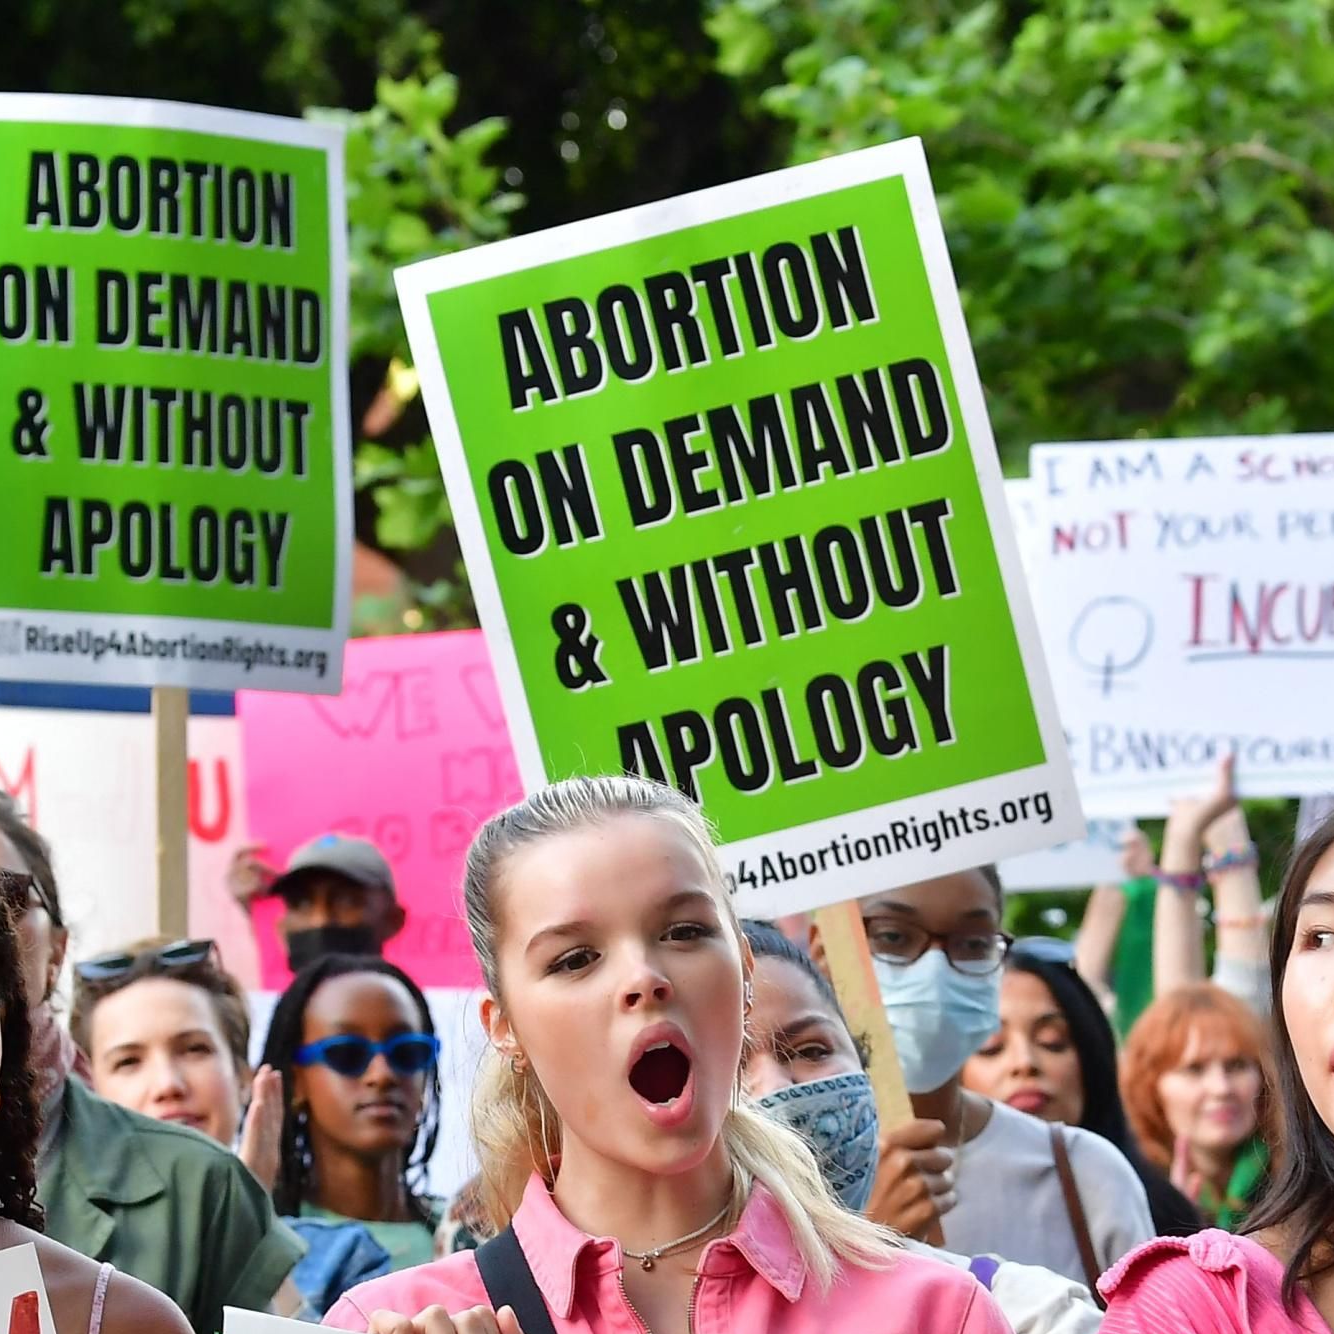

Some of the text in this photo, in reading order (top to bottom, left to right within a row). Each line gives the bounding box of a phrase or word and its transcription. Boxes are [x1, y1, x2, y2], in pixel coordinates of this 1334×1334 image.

[26, 152, 294, 250] ABORTION
[96, 270, 323, 367] DEMAND
[498, 226, 878, 411] ABORTION
[13, 383, 312, 478] & WITHOUT
[487, 357, 952, 558] ON DEMAND
[1044, 457, 1065, 496] I
[1087, 450, 1164, 490] AM
[1185, 451, 1217, 481] A
[40, 497, 289, 590] APOLOGY
[1051, 511, 1135, 555] NOT
[1155, 509, 1263, 551] YOUR
[551, 498, 961, 691] & WITHOUT
[25, 625, 328, 677] RiseUp4AbortionRights.org
[617, 645, 956, 802] APOLOGY
